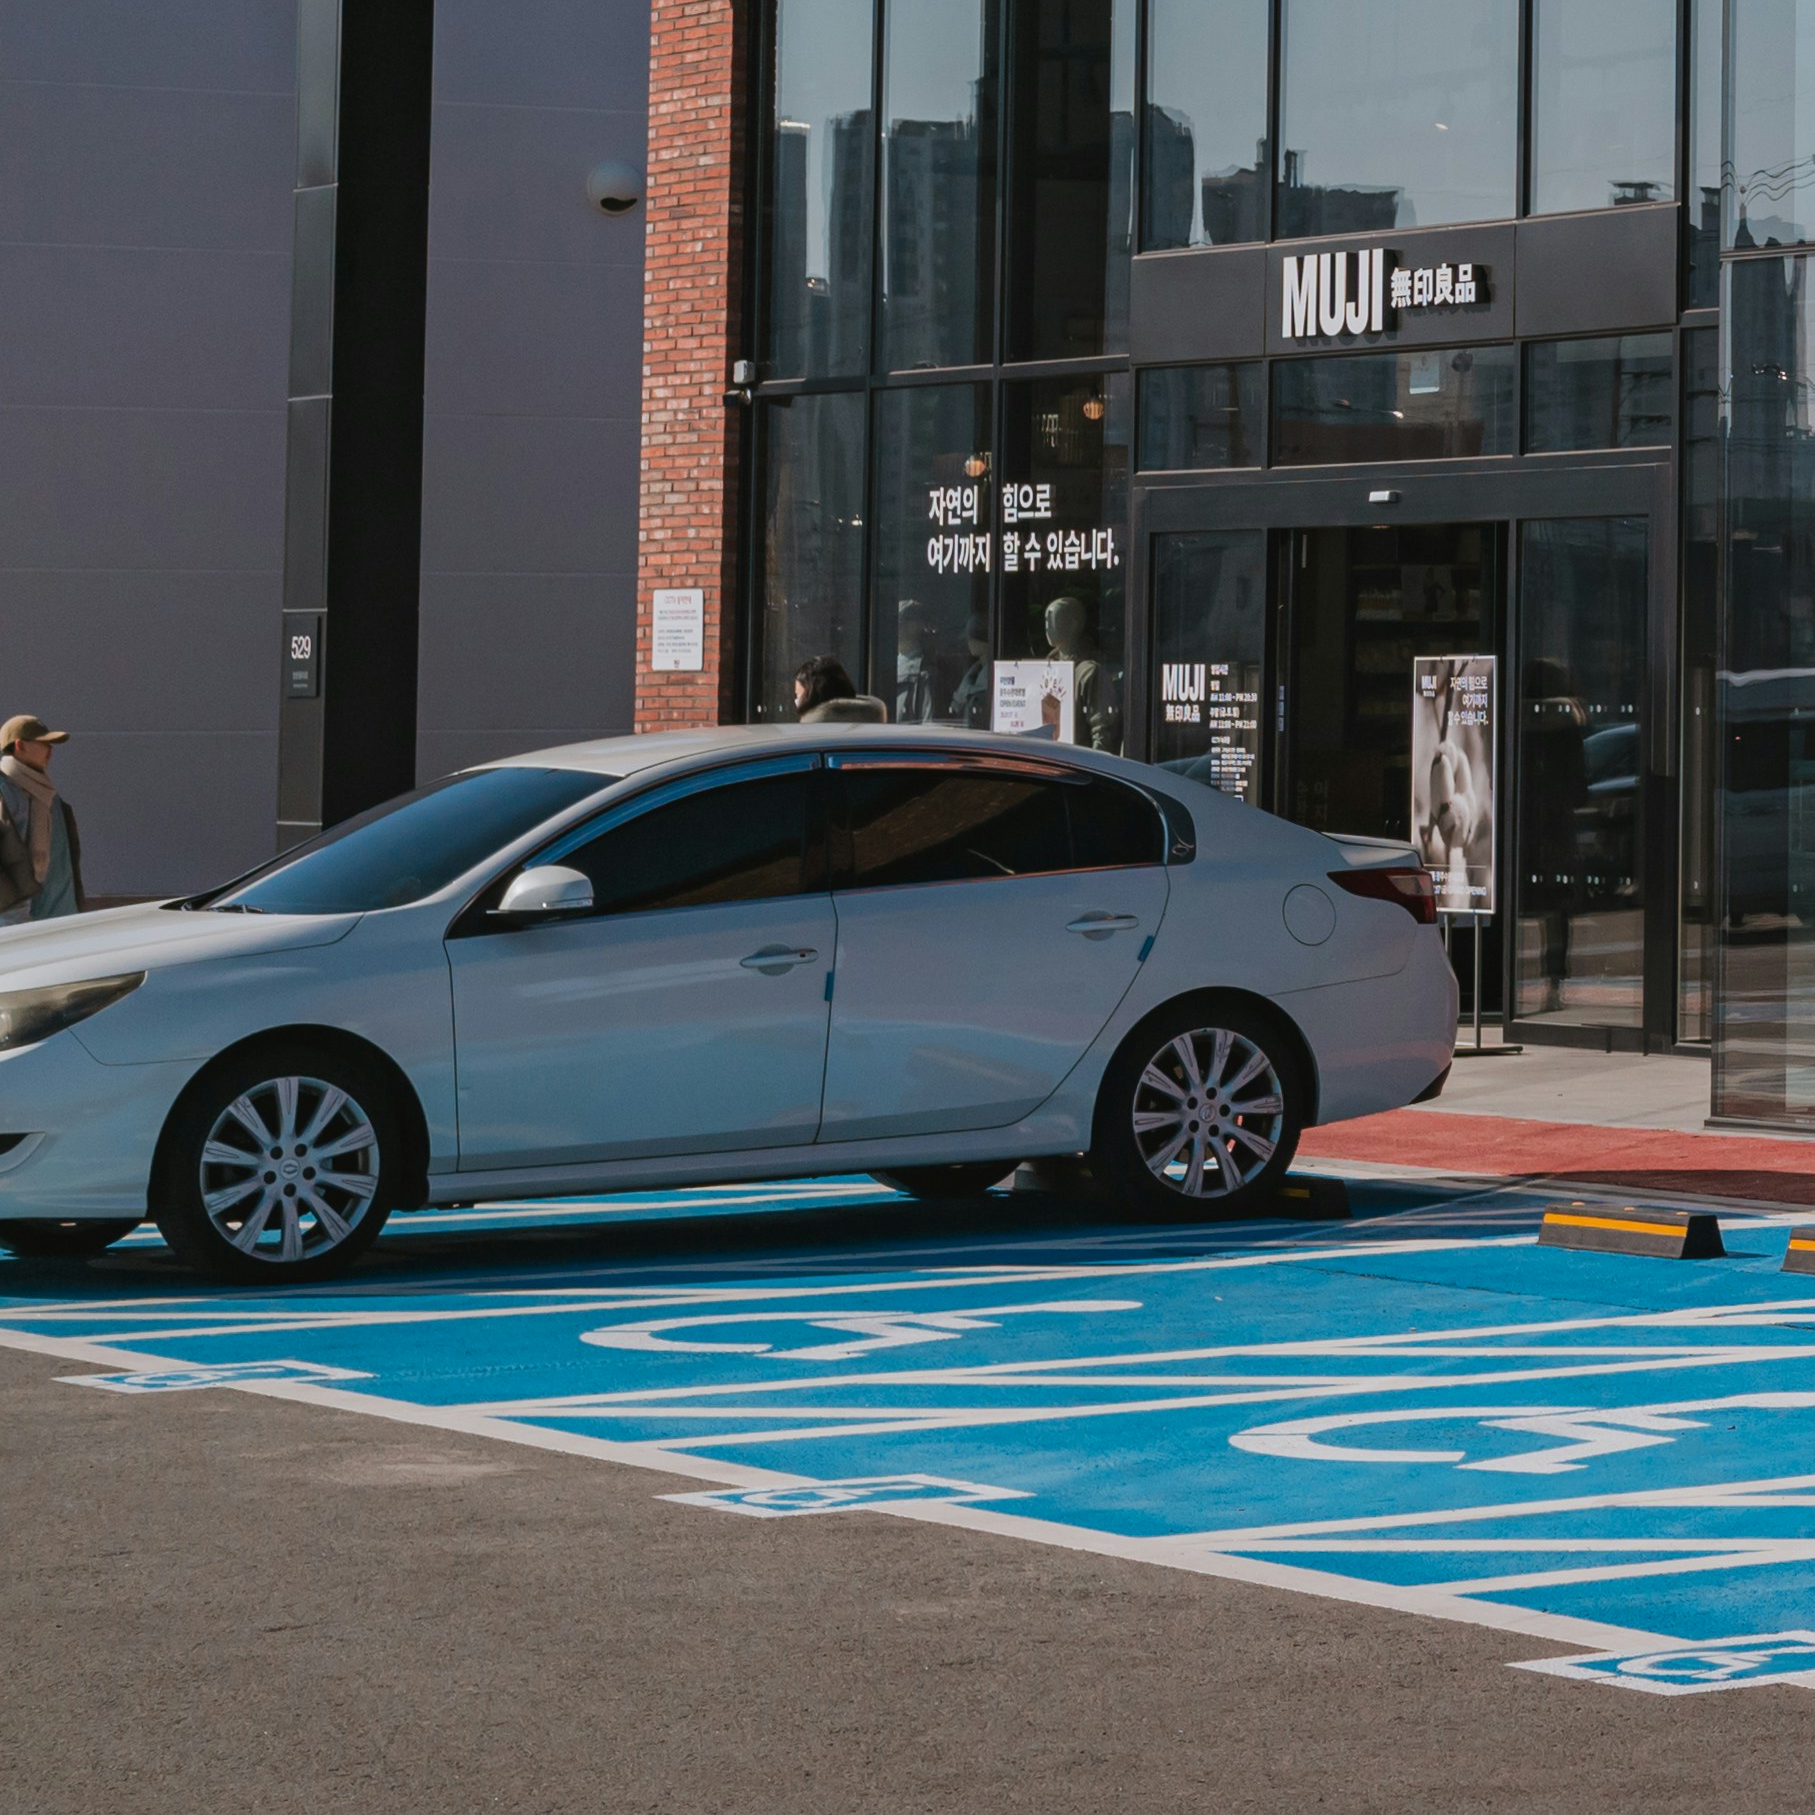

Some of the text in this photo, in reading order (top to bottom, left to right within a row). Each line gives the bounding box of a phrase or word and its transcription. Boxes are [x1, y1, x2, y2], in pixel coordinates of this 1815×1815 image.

[1282, 248, 1476, 338] MUJI 無印良品
[928, 482, 1052, 527] 자연의 힘으로
[927, 527, 1120, 575] 여기까지 할 수 있습니다.
[291, 636, 312, 660] 529
[1162, 663, 1206, 702] MUJI
[1165, 703, 1201, 723] 無印良品
